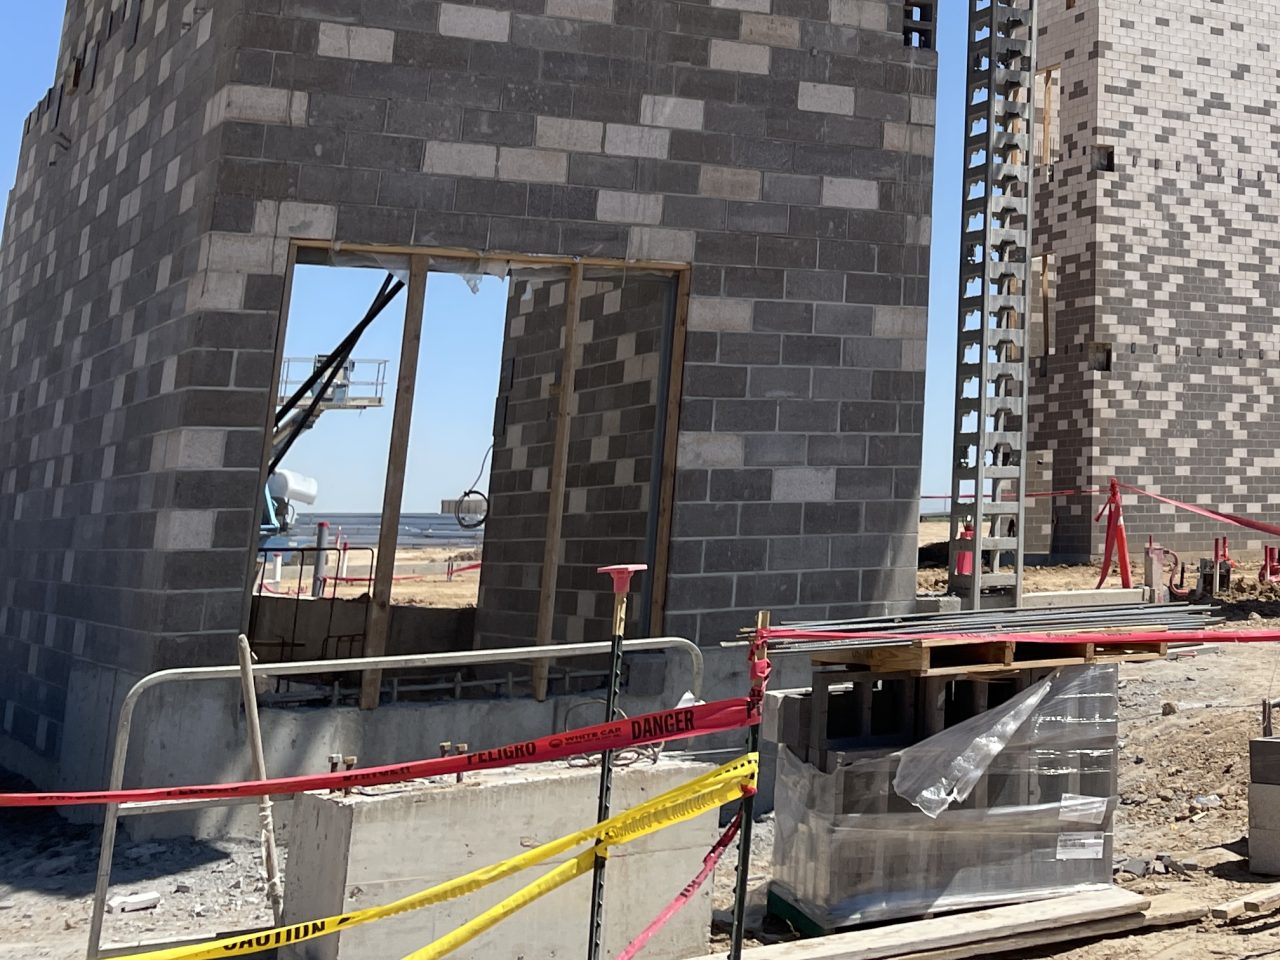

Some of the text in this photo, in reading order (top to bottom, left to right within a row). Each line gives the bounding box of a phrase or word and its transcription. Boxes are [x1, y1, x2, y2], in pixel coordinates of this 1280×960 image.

[564, 730, 599, 743] WHITE
[631, 709, 696, 741] DANGER
[466, 741, 537, 765] PELIGRO
